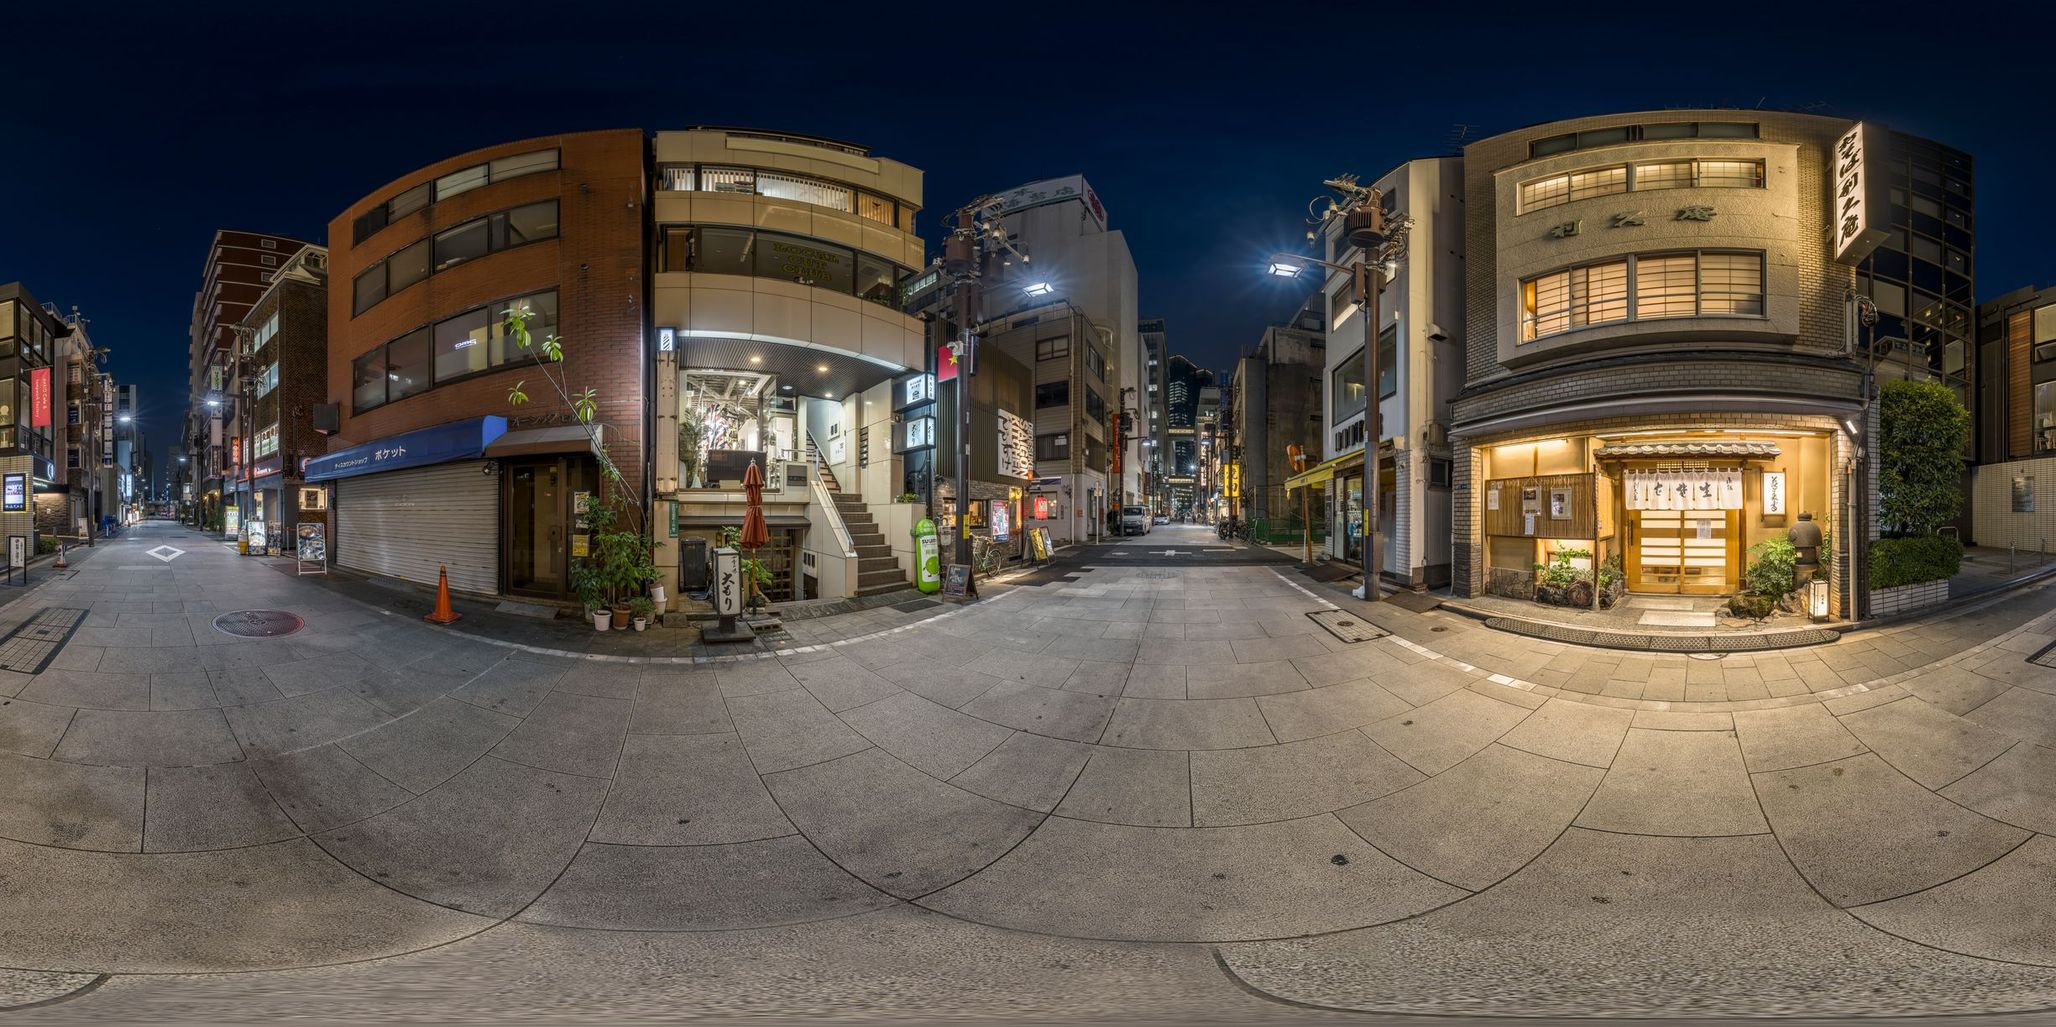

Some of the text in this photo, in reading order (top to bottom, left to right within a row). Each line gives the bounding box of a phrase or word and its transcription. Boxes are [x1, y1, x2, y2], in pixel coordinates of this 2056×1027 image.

[375, 445, 406, 461] ポケット
[1012, 416, 1021, 478] KITCHEN
[1019, 418, 1029, 480] SAIGON
[721, 571, 735, 611] 大もり
